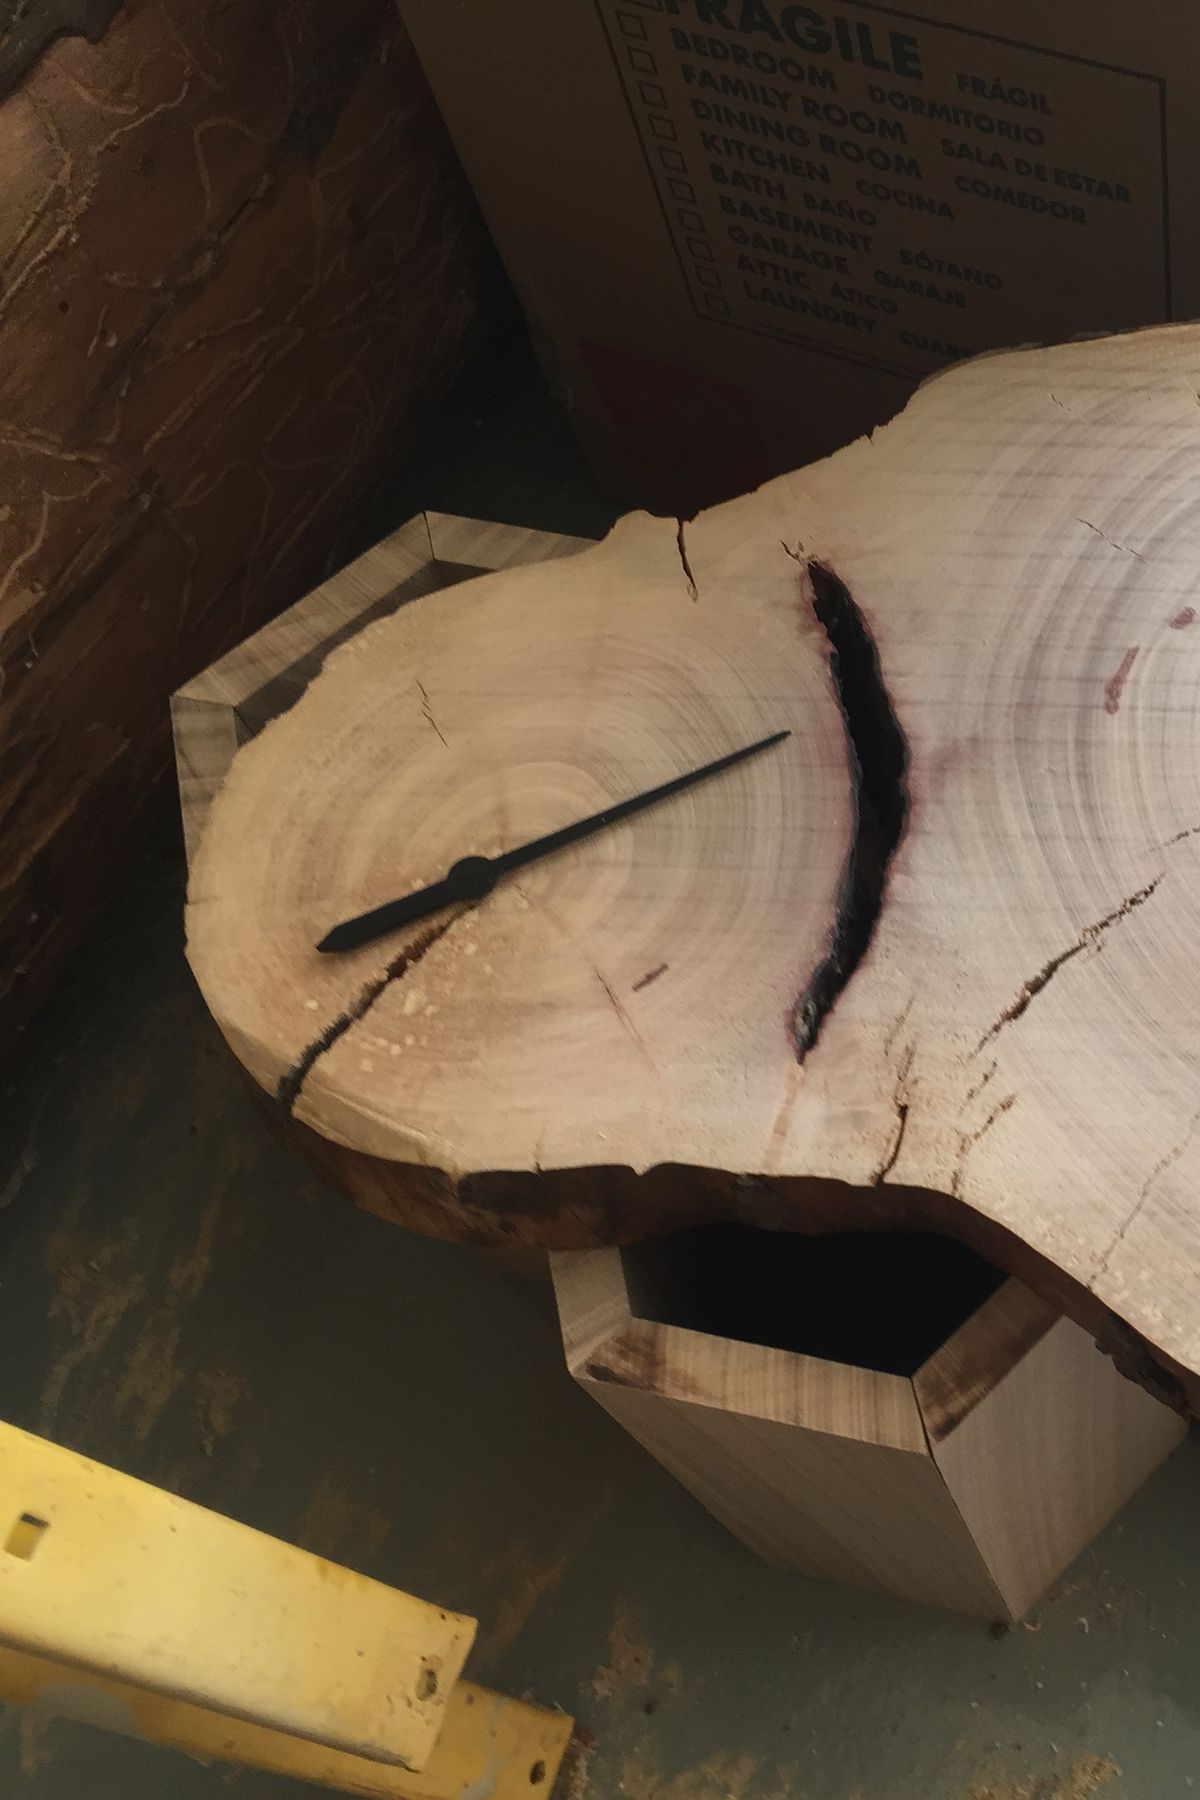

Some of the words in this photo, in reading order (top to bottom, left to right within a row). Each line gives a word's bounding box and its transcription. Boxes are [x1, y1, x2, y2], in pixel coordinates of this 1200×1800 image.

[670, 27, 837, 92] BEDROOM
[680, 63, 791, 111] FAMILY
[801, 96, 907, 144] ROOM
[869, 85, 1045, 146] DORMITORIO
[956, 73, 1053, 115] FRÁGIL
[691, 98, 809, 147] DINING
[819, 133, 922, 179] ROOM
[701, 131, 831, 184] KITCHEN
[710, 163, 786, 201] BATH
[941, 138, 1007, 170] SALA
[1015, 158, 1047, 181] DE
[1054, 168, 1131, 204] ESTAR
[719, 195, 872, 254] BASEMENT
[803, 192, 875, 226] BAÑO
[856, 179, 955, 220] COCINA
[955, 176, 1086, 225] COMEDOR
[728, 225, 849, 275] GARAGE
[738, 254, 810, 290] ATTIC
[900, 249, 1002, 289] SÓTANO
[743, 280, 875, 335] LAUNDRY
[874, 270, 967, 308] GARAJE
